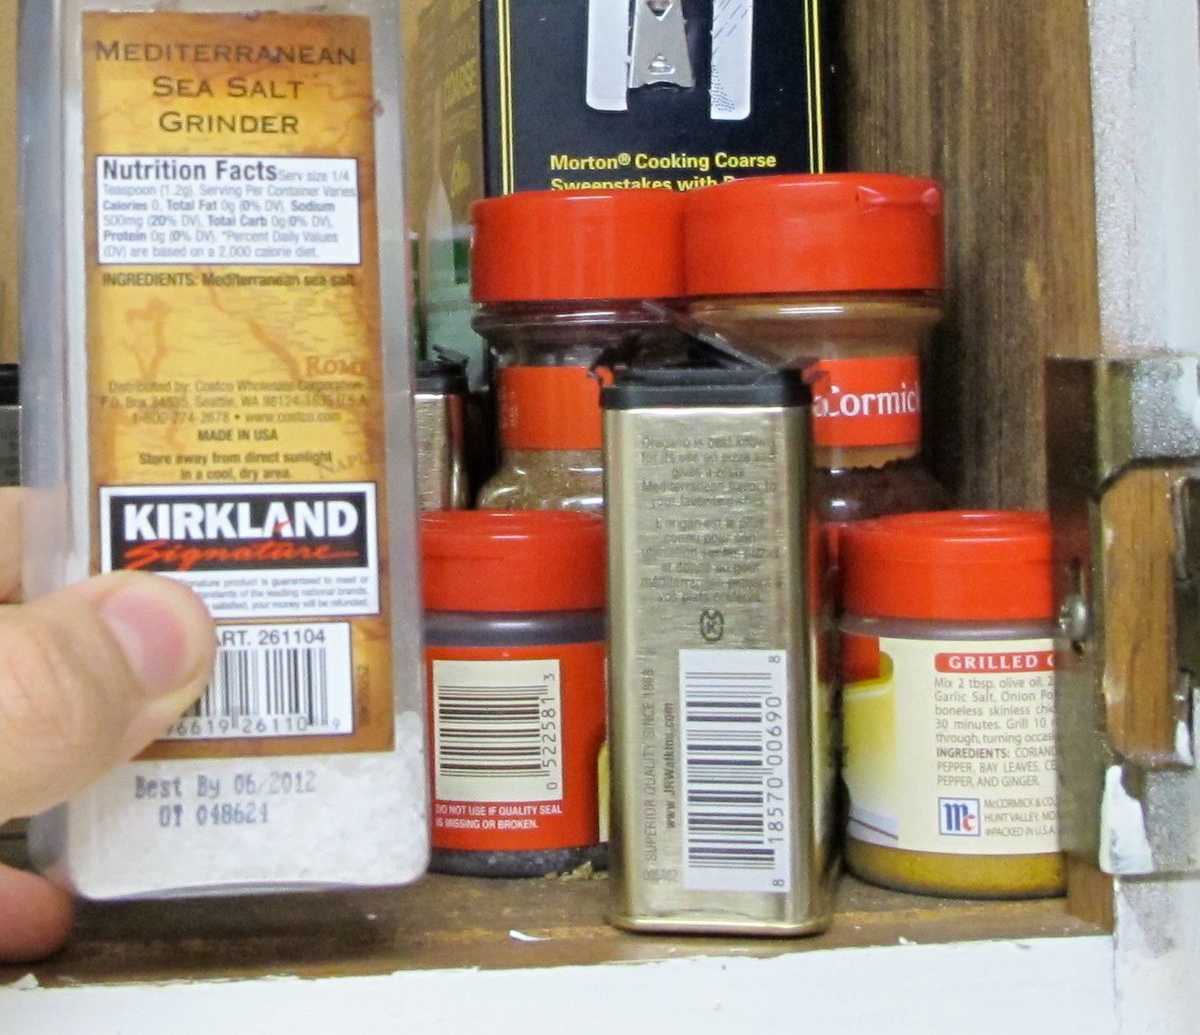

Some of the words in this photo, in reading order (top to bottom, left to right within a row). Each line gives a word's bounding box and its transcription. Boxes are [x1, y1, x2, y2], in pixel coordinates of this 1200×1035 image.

[95, 40, 356, 66] MEDITERRANEAN
[153, 75, 214, 98] SEA
[228, 76, 304, 99] SALT
[159, 111, 300, 134] GRINDER
[635, 153, 710, 172] Cooking
[715, 151, 778, 169] Coarse
[103, 159, 207, 181] Nutrition
[216, 160, 277, 182] Facts
[307, 170, 328, 182] size
[332, 169, 349, 182] 1/4
[677, 175, 718, 191] with
[103, 184, 157, 198] Teaspoon
[199, 184, 242, 198] Serving
[246, 184, 264, 198] Per
[267, 184, 320, 198] Container
[103, 199, 148, 213] Calories
[167, 199, 195, 213] Total
[199, 199, 217, 213] Fat
[291, 199, 335, 213] Sodium
[208, 215, 236, 229] Total
[240, 215, 267, 229] Carb
[103, 230, 147, 244] Protein
[272, 230, 300, 244] Daily
[303, 230, 339, 244] Values
[130, 245, 149, 259] are
[152, 245, 187, 259] based
[190, 245, 204, 259] on
[255, 245, 293, 259] calorie
[202, 272, 300, 287] Mediterranean
[304, 275, 327, 287] sea
[197, 429, 234, 443] MADE
[238, 429, 250, 443] IN
[254, 429, 279, 442] USA
[139, 453, 173, 466] Store
[175, 455, 208, 468] away
[212, 452, 241, 466] from
[244, 452, 280, 465] direct
[284, 450, 333, 467] sunlight
[181, 468, 192, 481] in
[207, 468, 236, 482] cool,
[239, 468, 260, 482] dry
[123, 500, 360, 542] KIRKLAND
[123, 538, 360, 572] Signature
[258, 628, 327, 646] 261104
[768, 654, 781, 663] 8
[948, 654, 1038, 670] GRILLED
[543, 672, 556, 682] 3
[935, 677, 952, 688] Mix
[958, 677, 964, 688] 2
[969, 676, 995, 692] tbsp.
[999, 676, 1025, 688] olive
[1029, 676, 1044, 688] oil,
[935, 691, 967, 703] Garlic
[972, 691, 997, 704] Salt,
[1001, 690, 1036, 703] Onion
[935, 704, 983, 716] boneless
[989, 703, 1031, 715] skinless
[642, 701, 655, 739] SINCE
[936, 719, 948, 729] 30
[954, 719, 1002, 730] minutes.
[1006, 717, 1029, 729] Grill
[1034, 717, 1047, 728] 10
[541, 696, 557, 768] 522581
[765, 696, 783, 766] 00690
[936, 732, 981, 746] through,
[983, 732, 1022, 746] turning
[937, 746, 1011, 759] INGREDIENTS:
[642, 743, 656, 796] QUALITY
[937, 761, 976, 773] PEPPER,
[979, 761, 1000, 773] BAY
[1003, 761, 1041, 773] LEAVES,
[134, 774, 183, 799] Best
[197, 774, 221, 799] By
[546, 781, 558, 791] 0
[937, 776, 975, 788] PEPPER,
[977, 776, 999, 788] AND
[1001, 775, 1041, 787] GINGER.
[436, 804, 448, 814] DO
[449, 804, 467, 815] NOT
[468, 804, 486, 816] USE
[488, 805, 497, 816] IF
[498, 805, 538, 816] QUALITY
[539, 803, 563, 815] SEAL
[766, 777, 784, 844] 18570
[436, 819, 444, 828] IS
[445, 819, 481, 829] MISSING
[482, 819, 496, 830] OR
[498, 819, 539, 830] BROKEN.
[984, 813, 1009, 823] HUNT
[643, 799, 658, 862] SUPERIOR
[772, 878, 785, 887] 8
